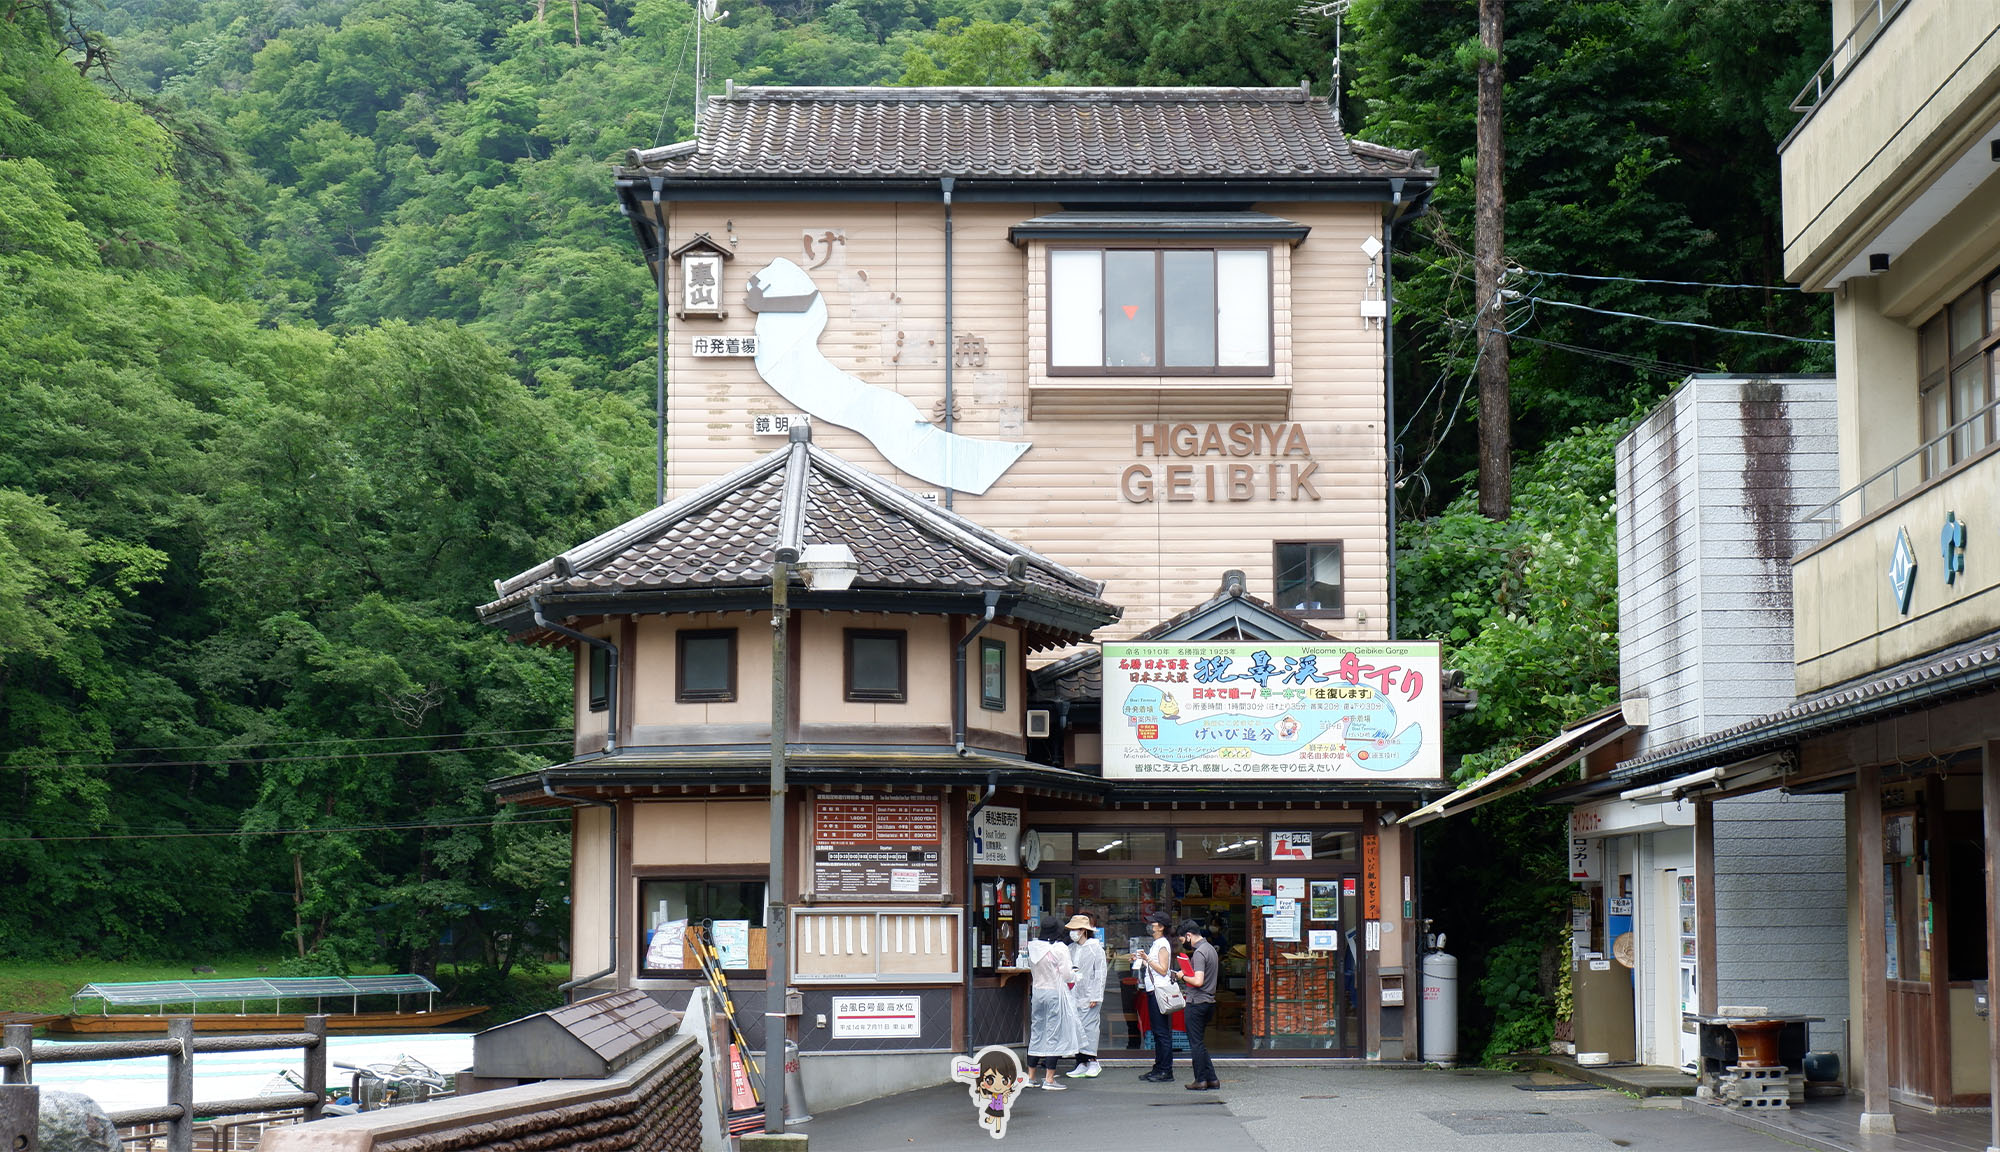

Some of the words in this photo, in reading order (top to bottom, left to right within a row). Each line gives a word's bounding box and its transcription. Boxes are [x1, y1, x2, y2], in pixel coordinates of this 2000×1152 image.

[803, 231, 846, 270] げ
[689, 262, 715, 305] 東山
[695, 338, 756, 355] 舟発着場
[756, 416, 808, 433] 鏡明
[1135, 422, 1311, 457] HIGASIYA
[1121, 463, 1322, 504] GEIBIK
[1143, 648, 1170, 656] 1910年
[1209, 648, 1237, 656] 1925年
[1301, 647, 1337, 655] Welcome
[1339, 647, 1346, 655] to
[1385, 647, 1409, 656] Gorge
[1118, 658, 1142, 670] 名勝
[1144, 658, 1190, 670] 日本百景
[1291, 833, 1311, 844] 売店
[839, 1002, 914, 1013] 台風6号最高水位
